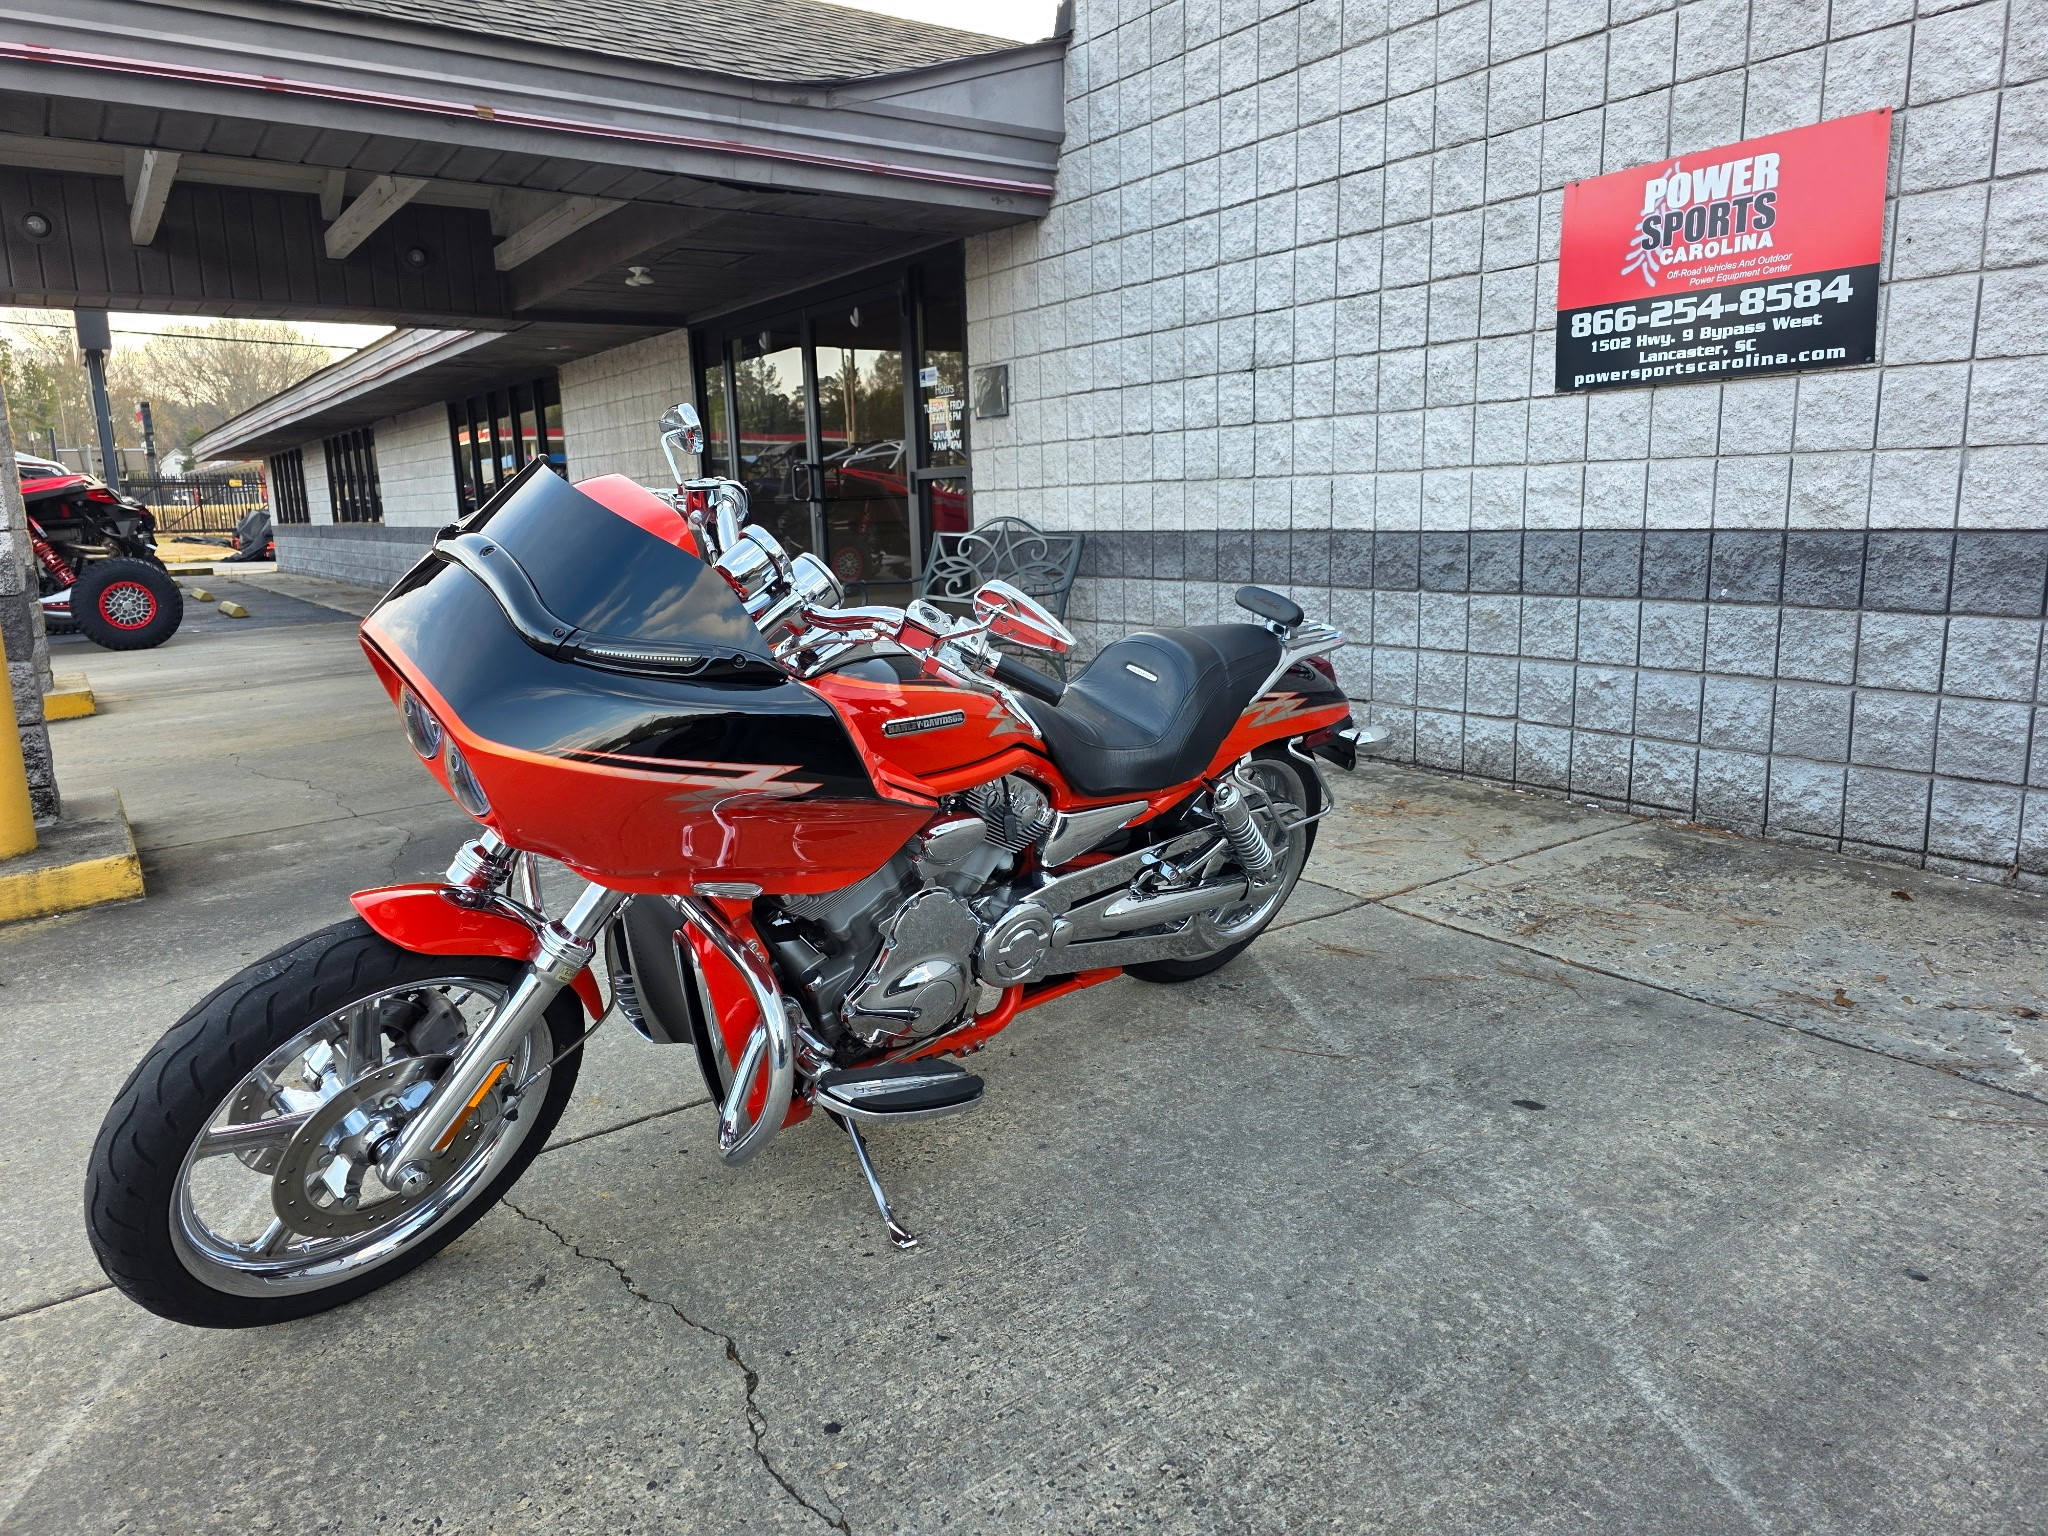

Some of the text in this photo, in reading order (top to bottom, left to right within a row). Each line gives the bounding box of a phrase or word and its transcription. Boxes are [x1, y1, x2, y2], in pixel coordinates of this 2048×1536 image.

[1644, 152, 1780, 214] POWER
[1641, 191, 1777, 250] SPORTS
[1660, 231, 1773, 265] CAROLINA
[1667, 252, 1793, 280] Off-Road Vehicles And Outdoor
[1690, 264, 1792, 286] Power Equipment Center
[1571, 274, 1854, 338] 866-254-8584
[1591, 313, 1823, 353] 1502 Hwy. 9 Bypass West
[1574, 347, 1846, 387] powersportscarolina.com
[1639, 339, 1757, 364] Lancaster, SC
[935, 385, 955, 395] Hours
[932, 429, 961, 441] SATURDAY
